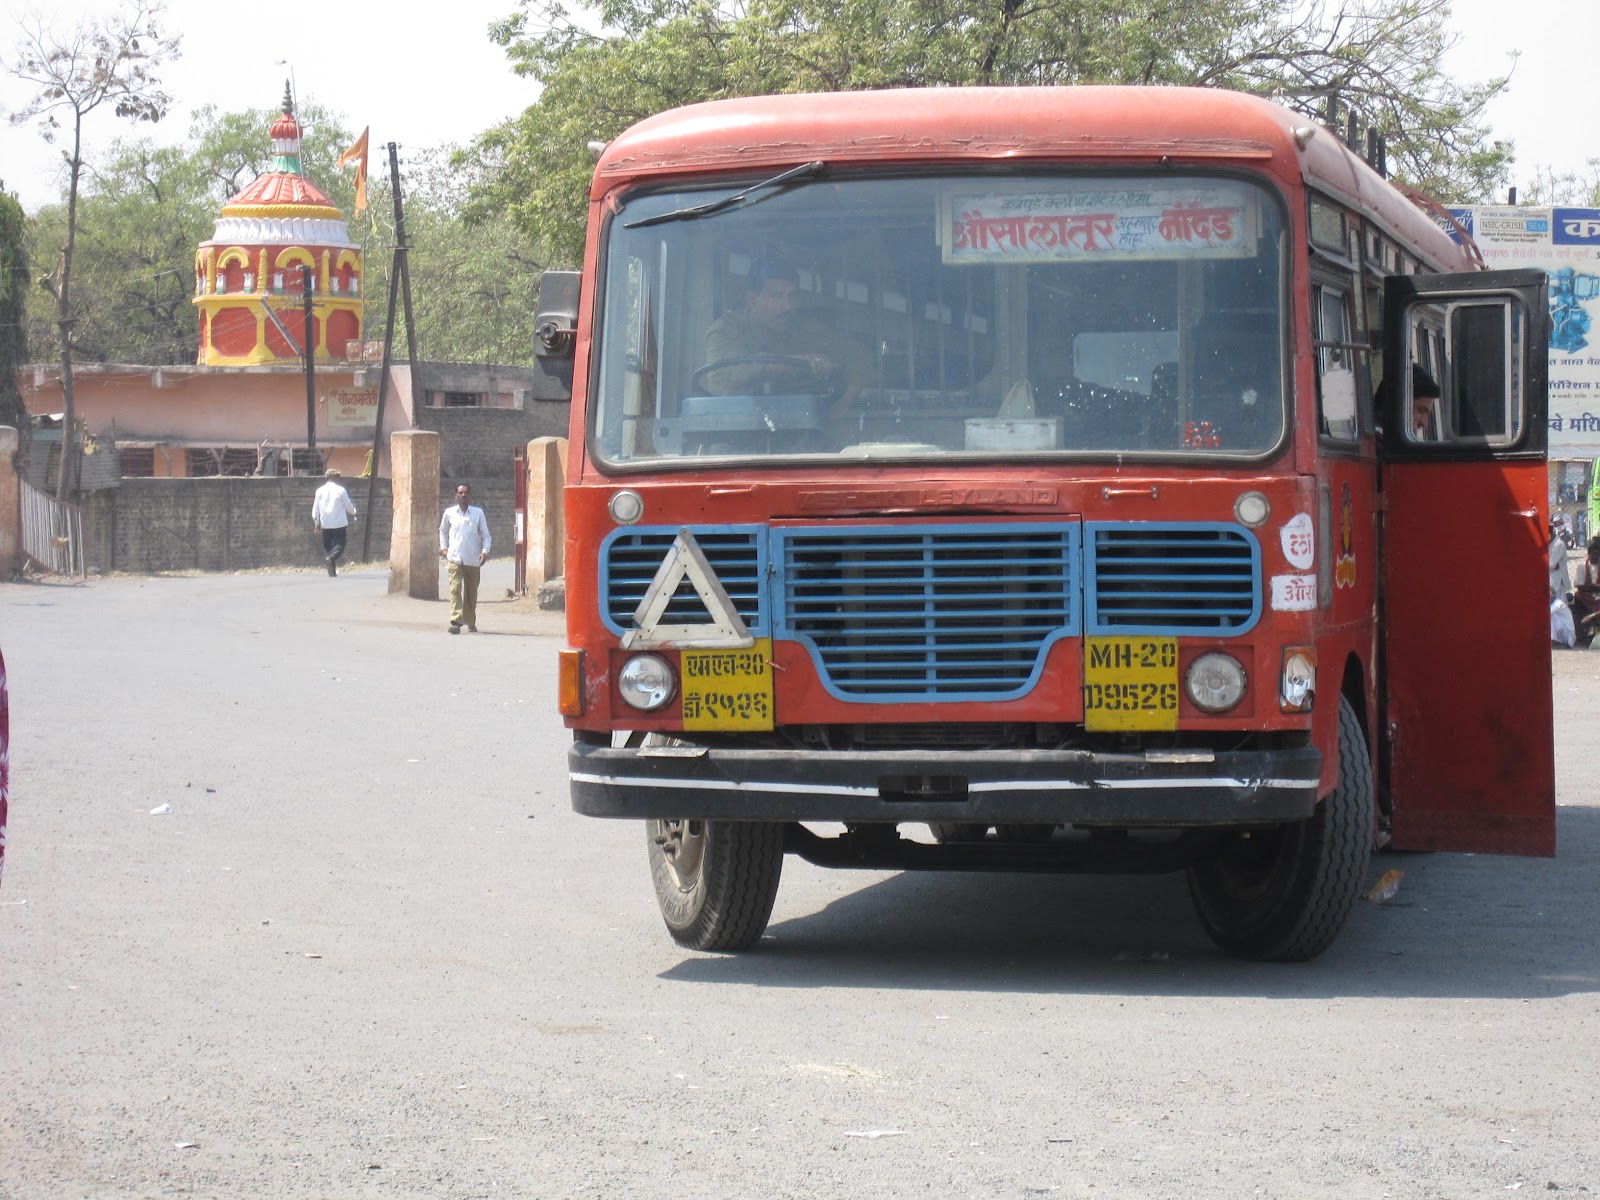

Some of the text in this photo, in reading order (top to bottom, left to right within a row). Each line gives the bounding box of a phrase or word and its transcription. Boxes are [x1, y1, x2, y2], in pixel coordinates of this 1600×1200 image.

[1482, 220, 1525, 230] NSIC-CRISIL
[919, 488, 1059, 506] LEYLAND
[1090, 643, 1177, 669] MH-20
[1086, 683, 1177, 711] D9526
